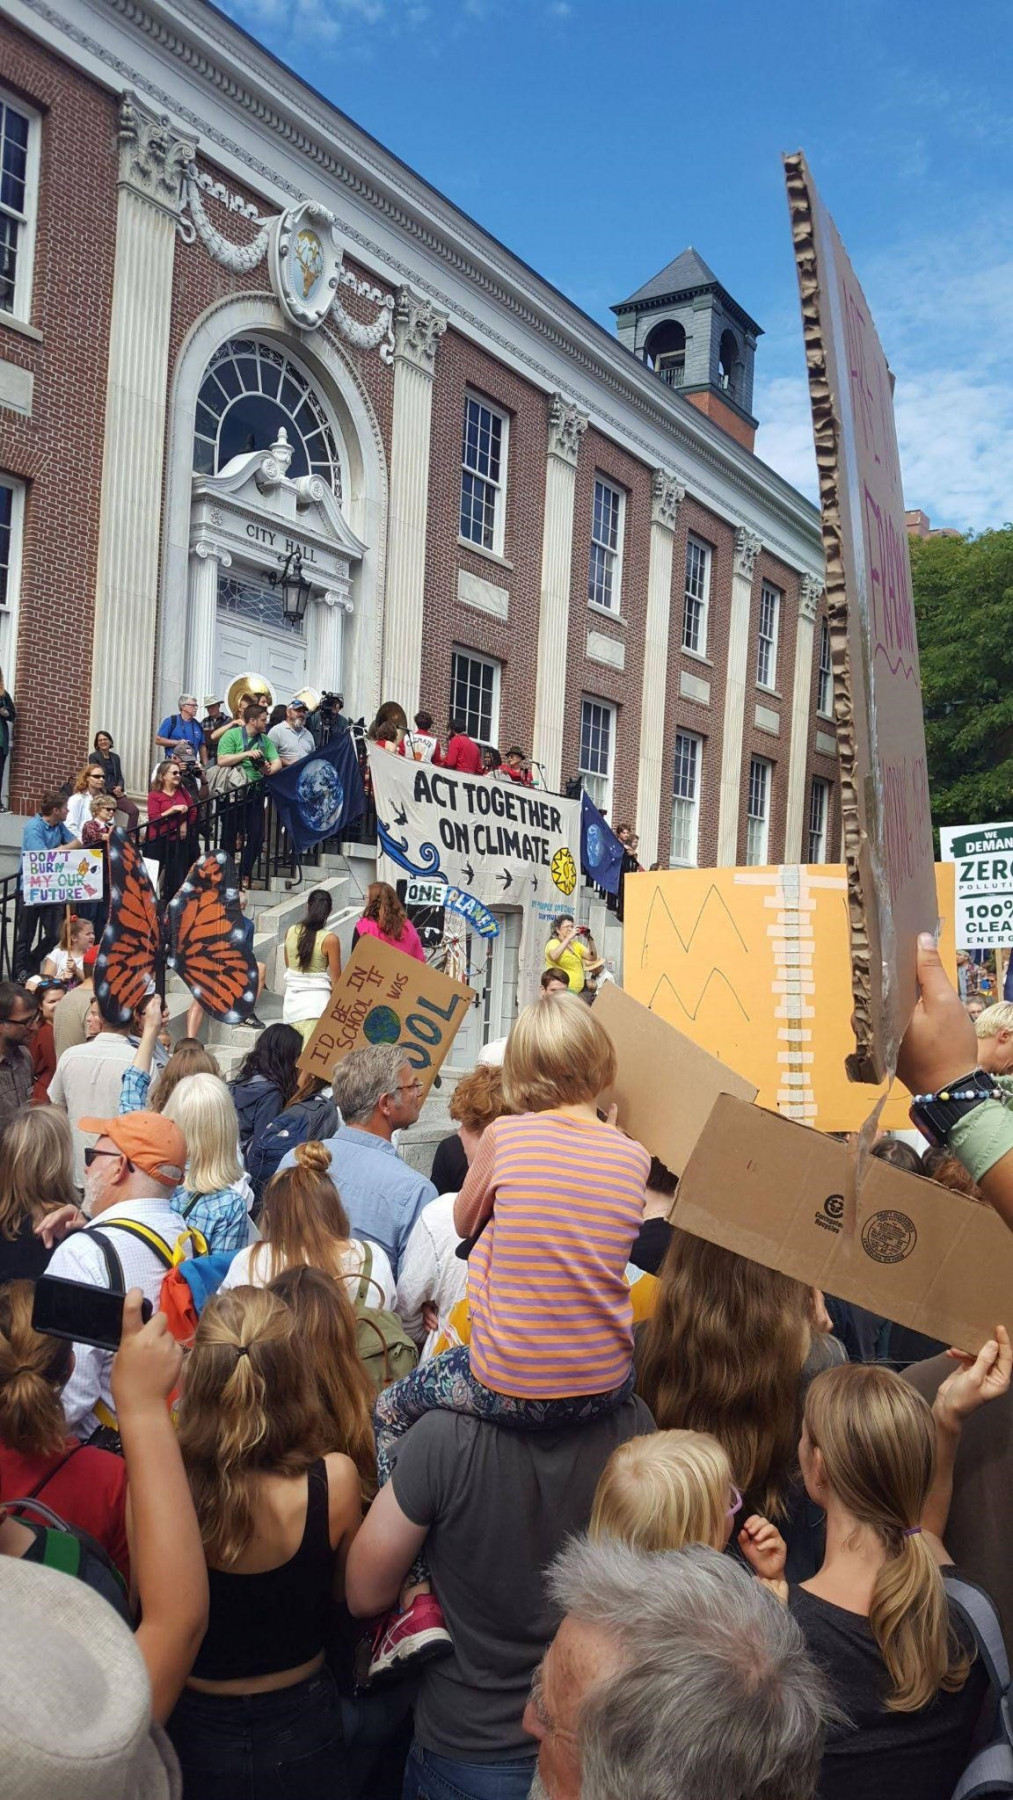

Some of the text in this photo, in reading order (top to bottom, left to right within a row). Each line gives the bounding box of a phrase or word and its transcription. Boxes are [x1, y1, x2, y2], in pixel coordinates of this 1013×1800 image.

[246, 524, 317, 563] CITY HALL
[414, 770, 562, 834] ACT TOGETHER
[439, 817, 551, 867] ON CLIMATE
[984, 831, 998, 839] WE
[966, 837, 1013, 853] DEMAN
[29, 851, 70, 862] DON'T
[31, 862, 65, 874] BURN
[959, 859, 1013, 882] ZER
[30, 874, 84, 887] MY OUR
[959, 882, 1013, 890] POLLUTI
[29, 888, 82, 901] FUTURE
[408, 884, 442, 902] ONE
[447, 889, 497, 934] PLANET
[966, 921, 1013, 933] CLEA
[967, 935, 1013, 943] ENERG
[386, 972, 409, 1000] WAS
[310, 965, 368, 1065] I'D BE IN
[337, 965, 385, 1050] SCHOOL IF
[399, 993, 461, 1069] OOL
